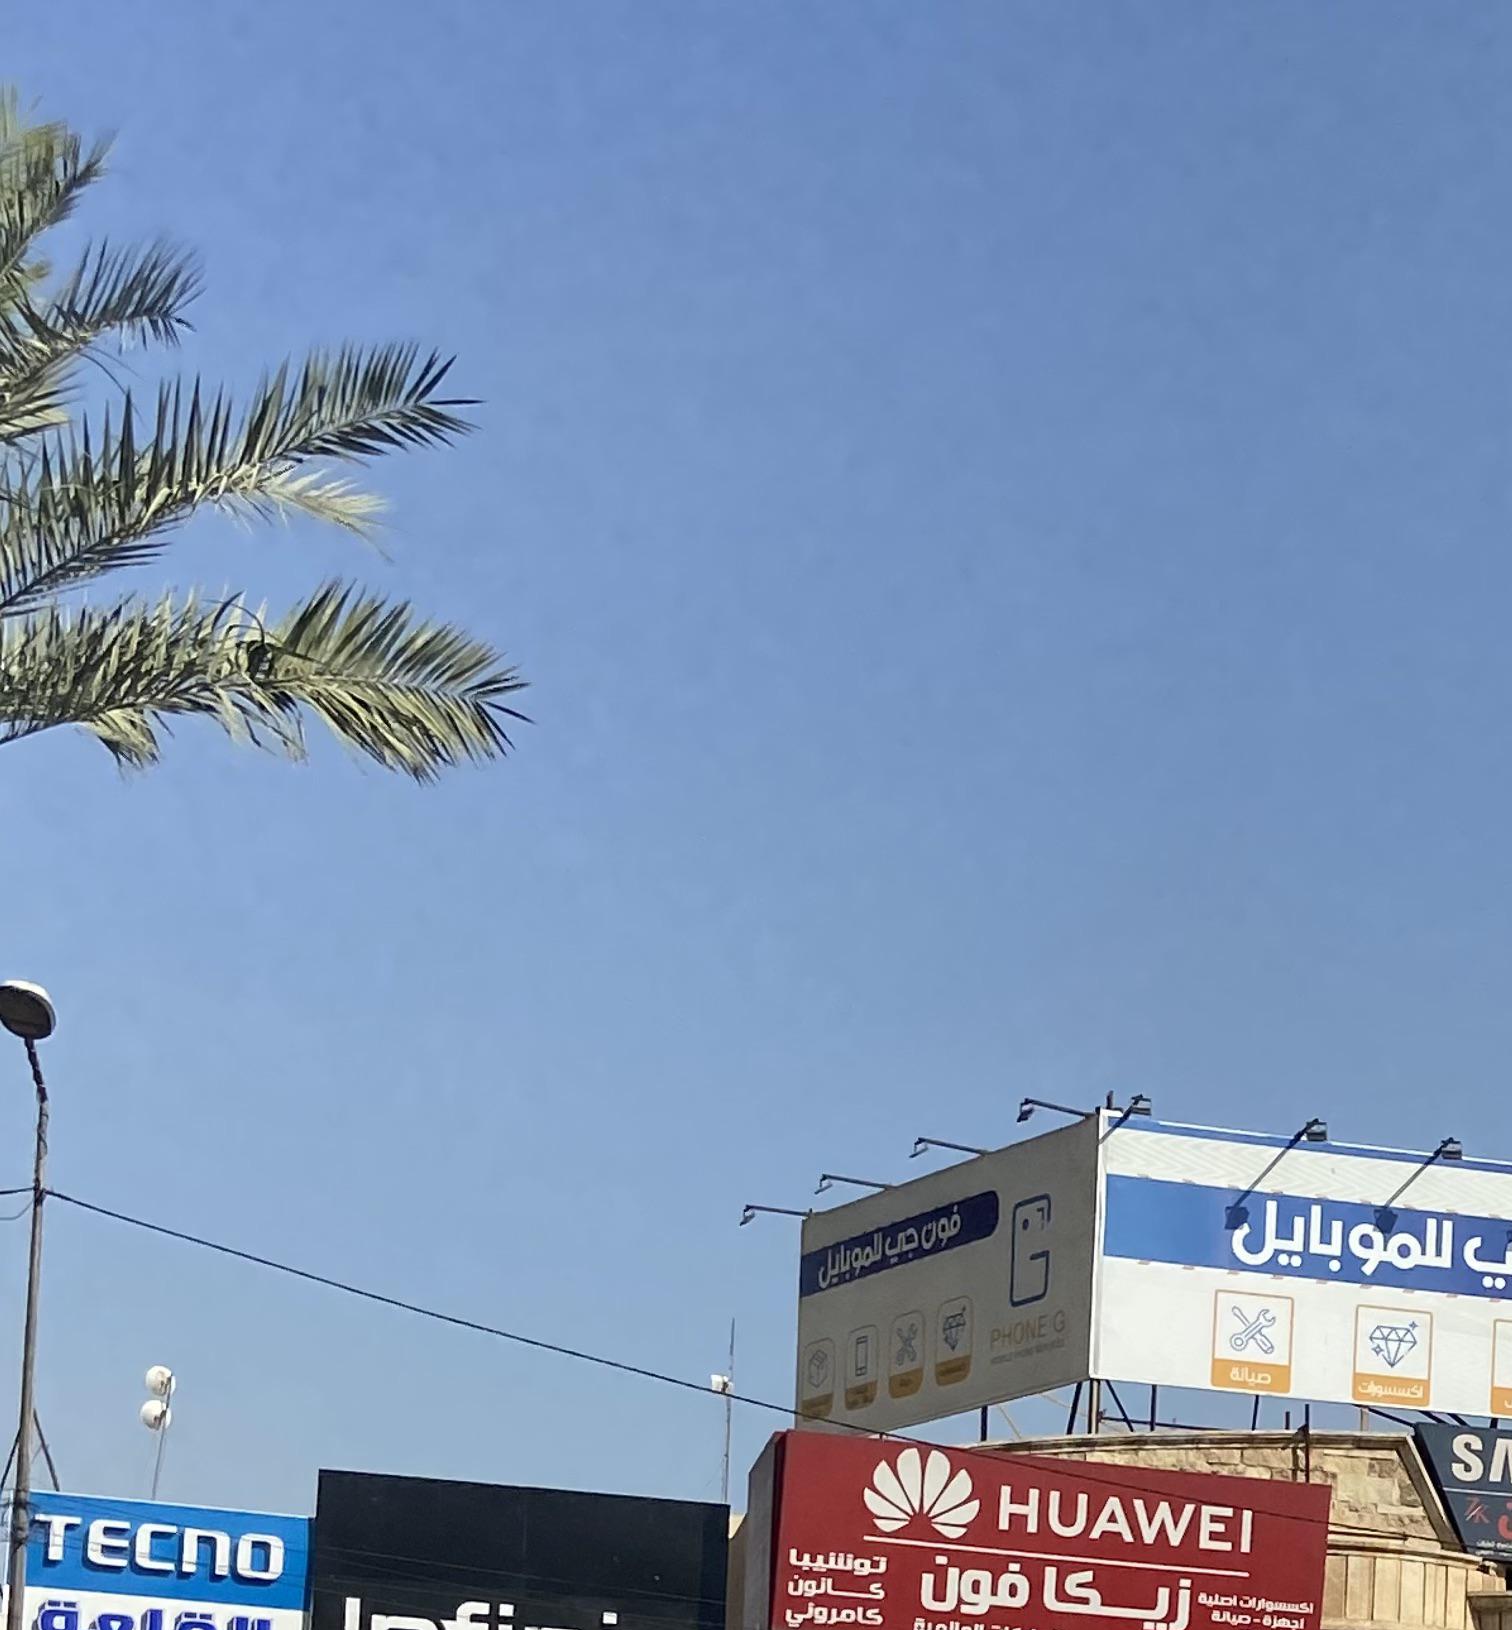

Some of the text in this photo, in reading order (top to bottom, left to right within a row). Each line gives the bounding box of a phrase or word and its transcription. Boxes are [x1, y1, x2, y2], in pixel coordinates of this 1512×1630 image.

[921, 1204, 961, 1249] فون
[1231, 1200, 1453, 1276] للموبايل
[818, 1231, 882, 1289] للموبايل
[990, 1310, 1066, 1346] PHONE G
[1230, 1367, 1272, 1386] صيانة
[998, 1484, 1252, 1553] HUAWEI
[34, 1513, 284, 1580] TECNO
[789, 1548, 888, 1576] توشيبا
[788, 1575, 886, 1599] كانون
[921, 1555, 1030, 1615] فون
[1198, 1592, 1314, 1614] اكسسوارات اصلية
[1211, 1610, 1305, 1630] اجهزة صيانة
